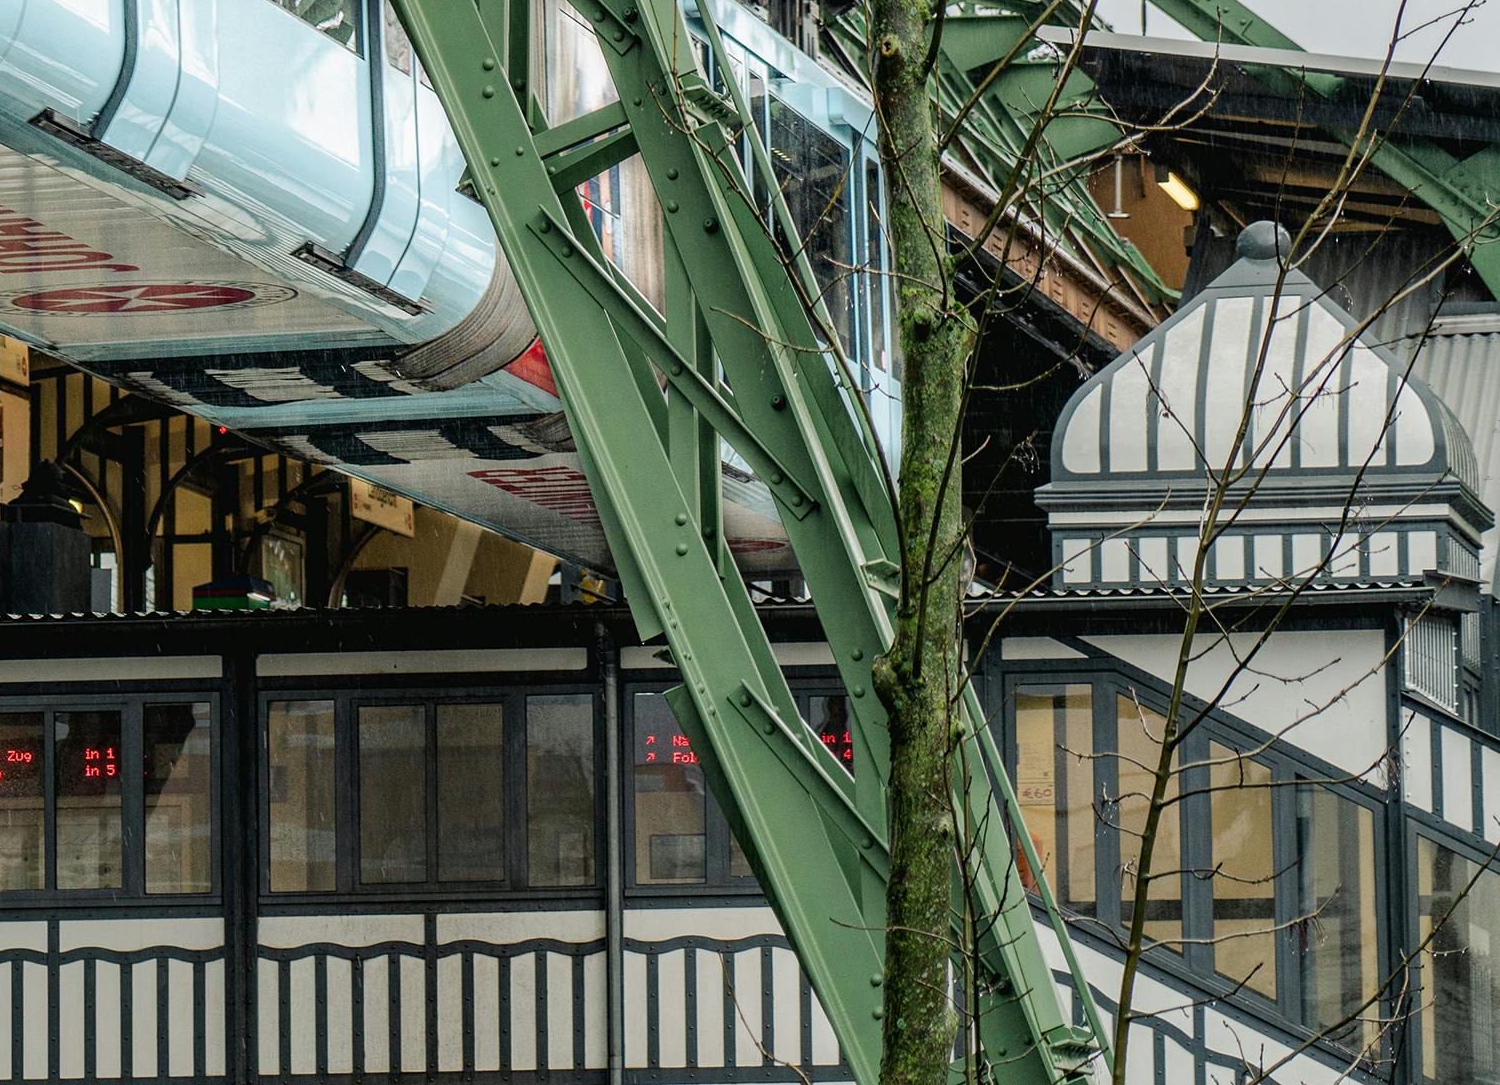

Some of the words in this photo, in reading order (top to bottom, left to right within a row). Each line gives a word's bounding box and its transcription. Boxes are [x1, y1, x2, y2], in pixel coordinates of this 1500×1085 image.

[821, 732, 836, 743] in
[7, 750, 32, 762] Zug
[85, 748, 100, 760] in
[106, 747, 115, 759] 1
[85, 765, 100, 776] in
[106, 764, 116, 776] 5
